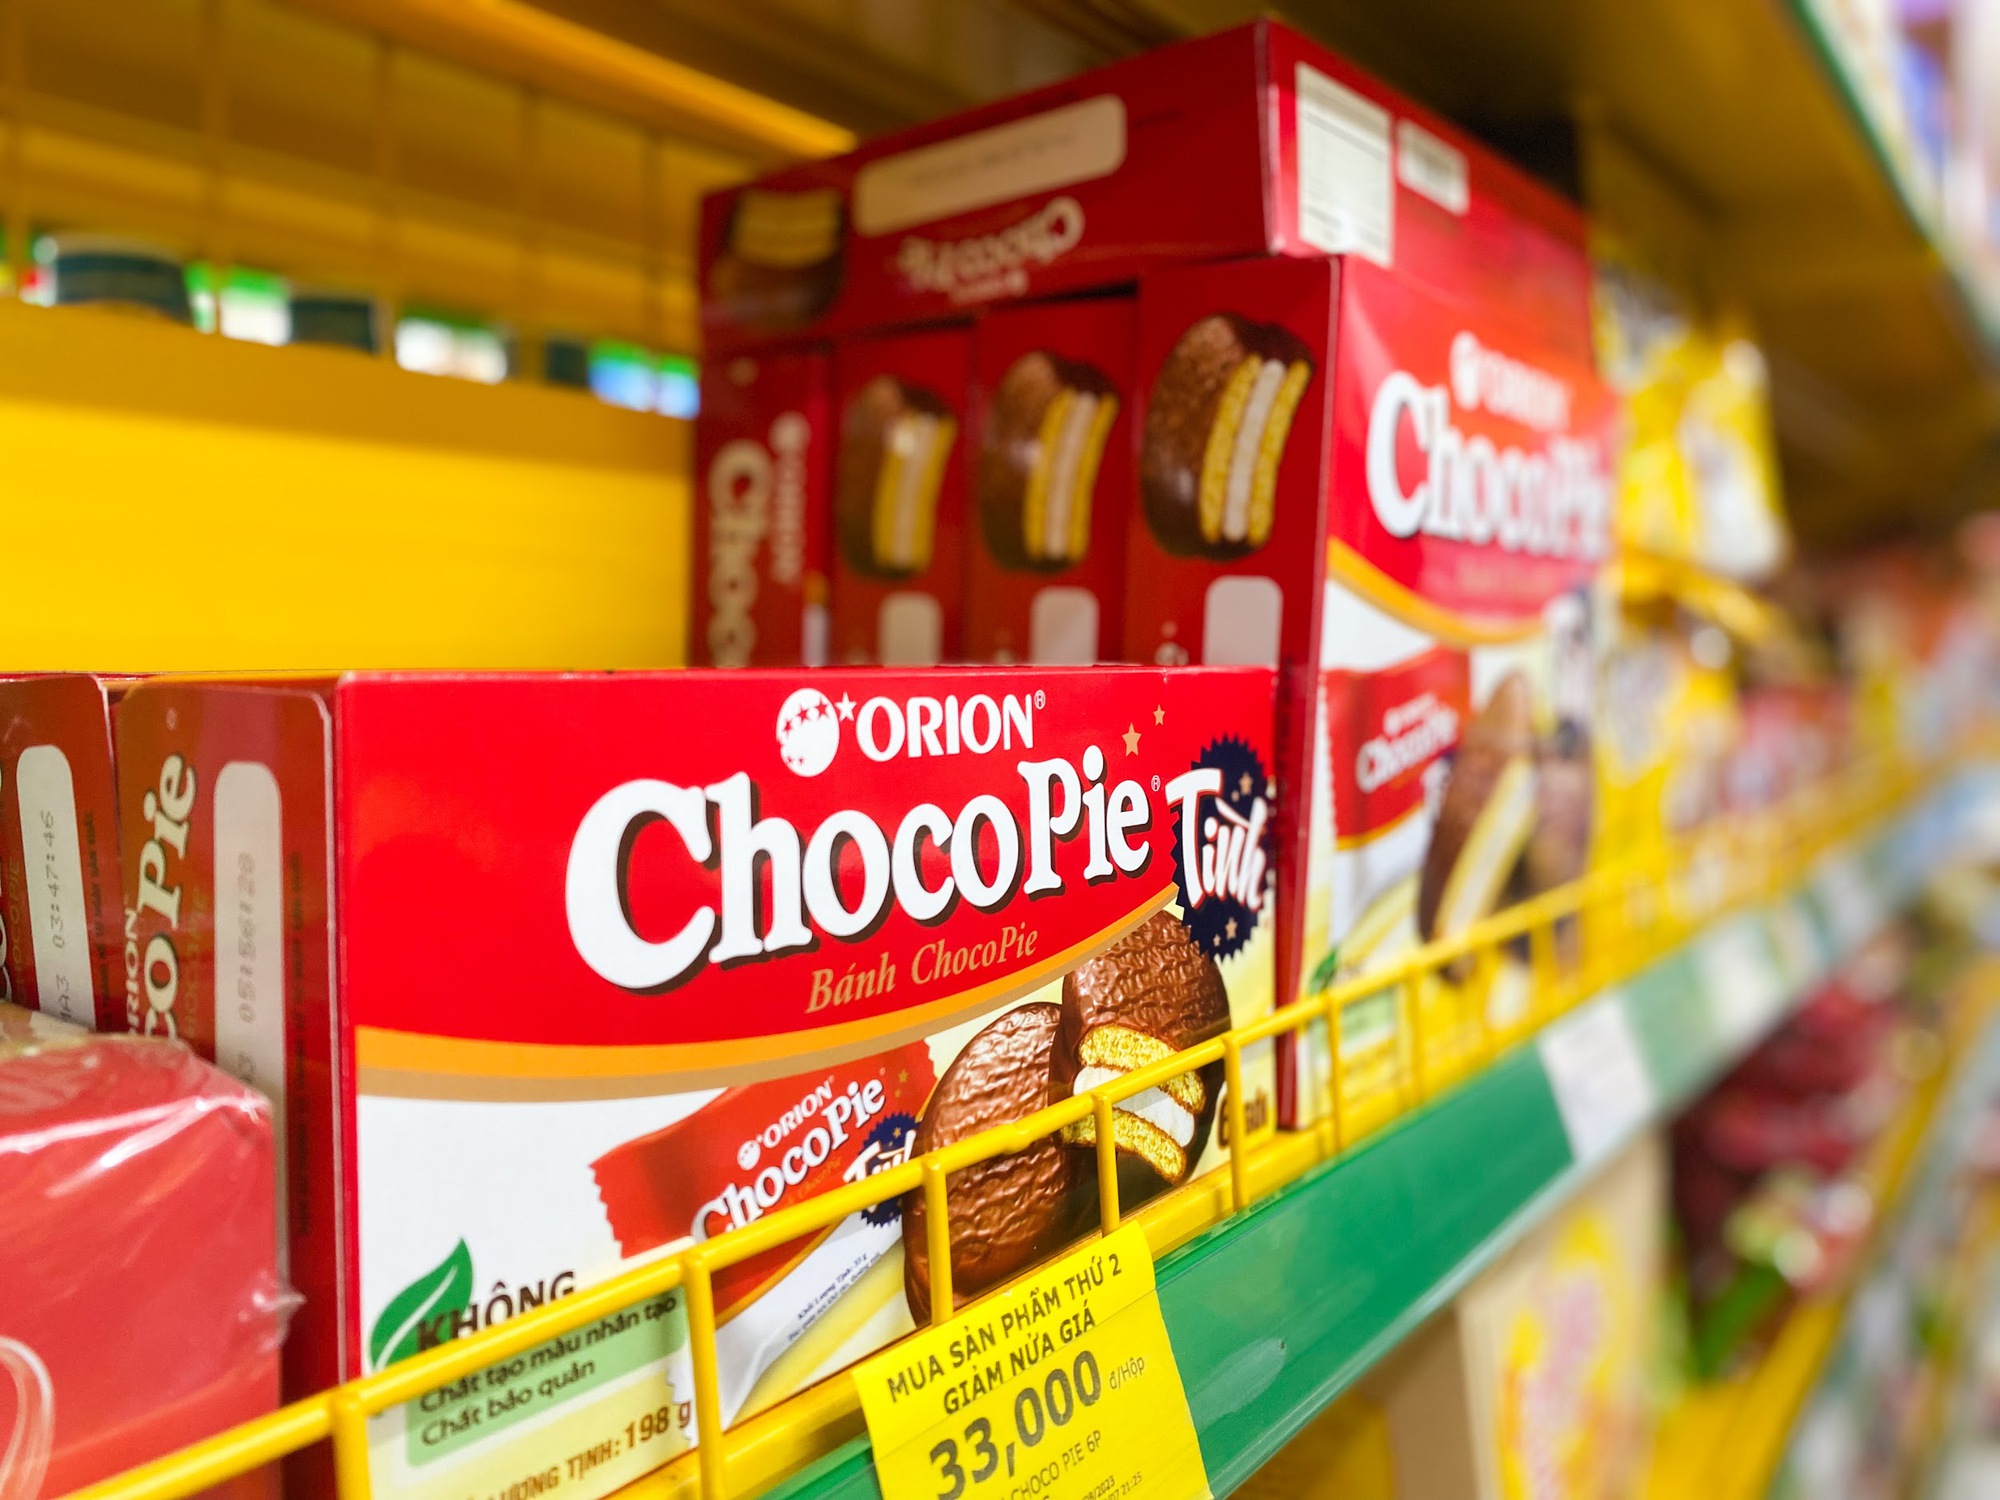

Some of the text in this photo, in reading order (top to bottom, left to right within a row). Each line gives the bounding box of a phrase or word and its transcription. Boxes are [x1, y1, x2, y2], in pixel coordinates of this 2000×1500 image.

[855, 692, 1034, 762] ORION
[565, 744, 1152, 990] ChocoPie
[124, 908, 141, 1037] RION
[805, 922, 1038, 1015] Bánh ChocoPie
[690, 1079, 886, 1243] ChocoPie
[763, 1079, 833, 1148] ORION
[417, 1270, 576, 1353] KHÔNG
[887, 1253, 1122, 1403] MUA SẢN PHẨM THỨ 2
[943, 1300, 1096, 1415] GIẢM NỬA GIÁ
[624, 1406, 670, 1449] 198
[679, 1401, 691, 1429] g
[929, 1350, 1102, 1500] 33,000
[1010, 1429, 1102, 1500] CHOCO PIE 6P
